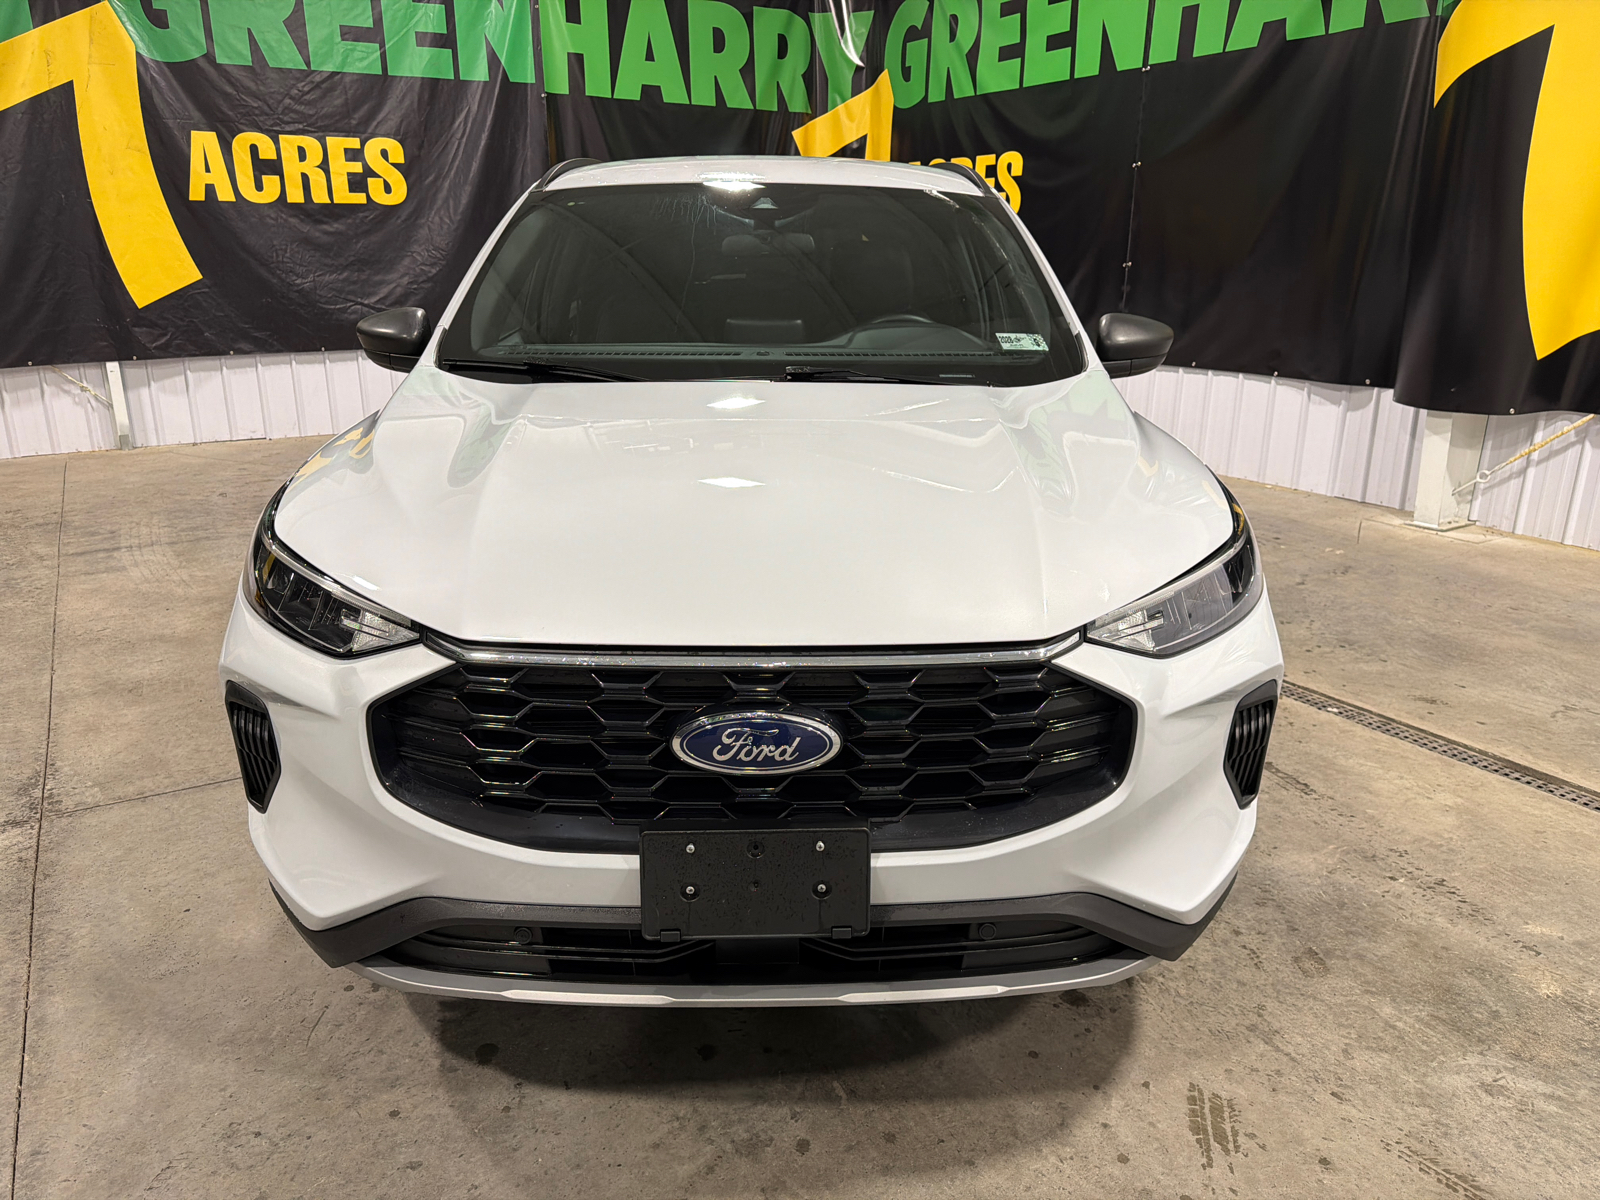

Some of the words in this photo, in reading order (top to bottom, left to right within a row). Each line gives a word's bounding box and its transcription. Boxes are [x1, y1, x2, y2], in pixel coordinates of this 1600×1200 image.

[539, 0, 875, 114] HARRY
[884, 0, 1148, 109] GREEN
[188, 129, 408, 206] ACRES
[712, 727, 801, 762] Ford
